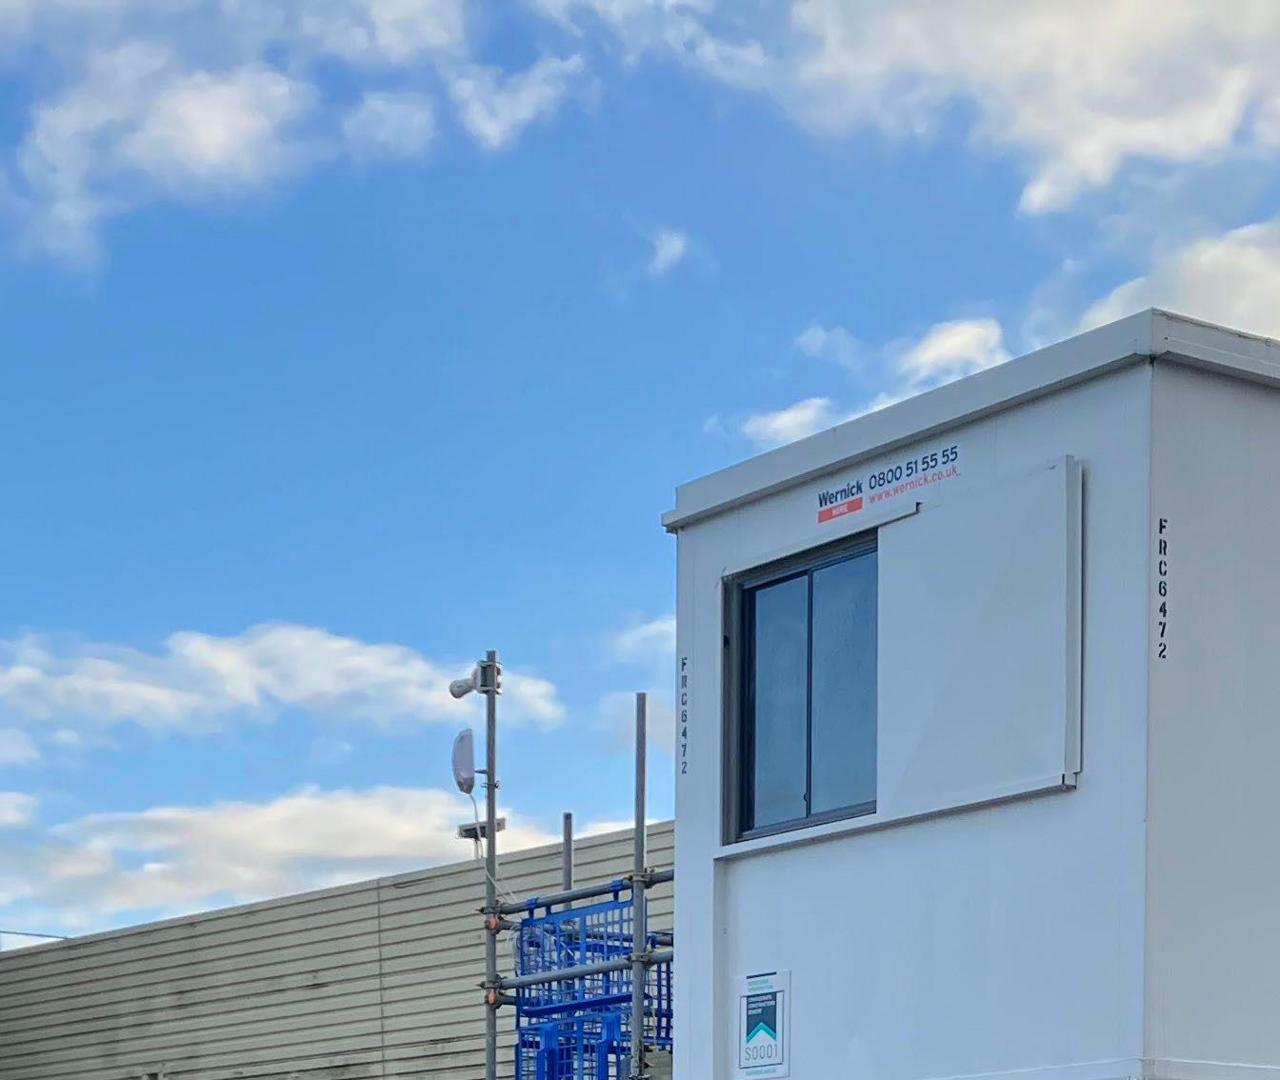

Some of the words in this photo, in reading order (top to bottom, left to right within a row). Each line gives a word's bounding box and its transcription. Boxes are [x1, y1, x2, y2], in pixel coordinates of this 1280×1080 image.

[818, 480, 863, 508] Wernick
[868, 465, 903, 490] 0800
[906, 459, 918, 477] 51
[921, 452, 938, 471] 55
[941, 445, 958, 465] 55
[868, 464, 958, 503] www.wernick.co.uk
[1158, 517, 1168, 659] FRC6472
